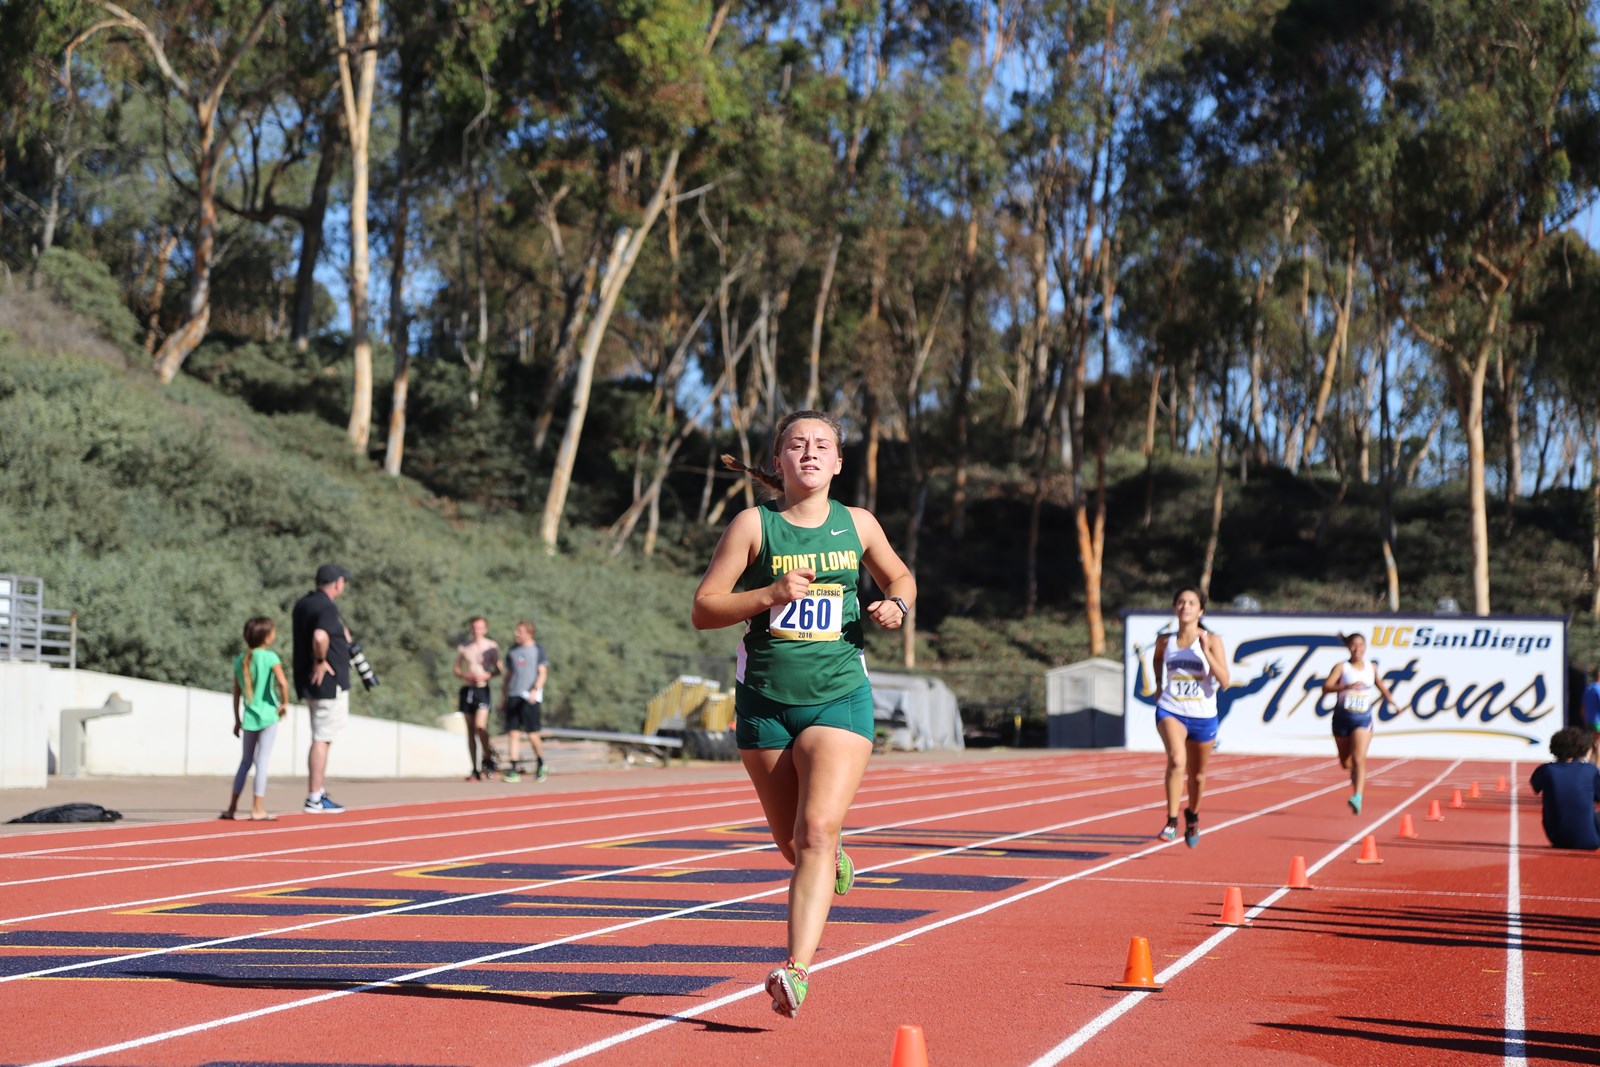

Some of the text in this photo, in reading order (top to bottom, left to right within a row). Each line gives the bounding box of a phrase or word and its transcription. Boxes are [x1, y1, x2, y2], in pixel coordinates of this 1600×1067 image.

[771, 549, 858, 576] POINT LOMA
[816, 587, 841, 597] Classic
[780, 598, 831, 630] 260
[798, 631, 813, 639] 2016
[1176, 681, 1200, 697] 128
[1233, 634, 1554, 723] Trtons
